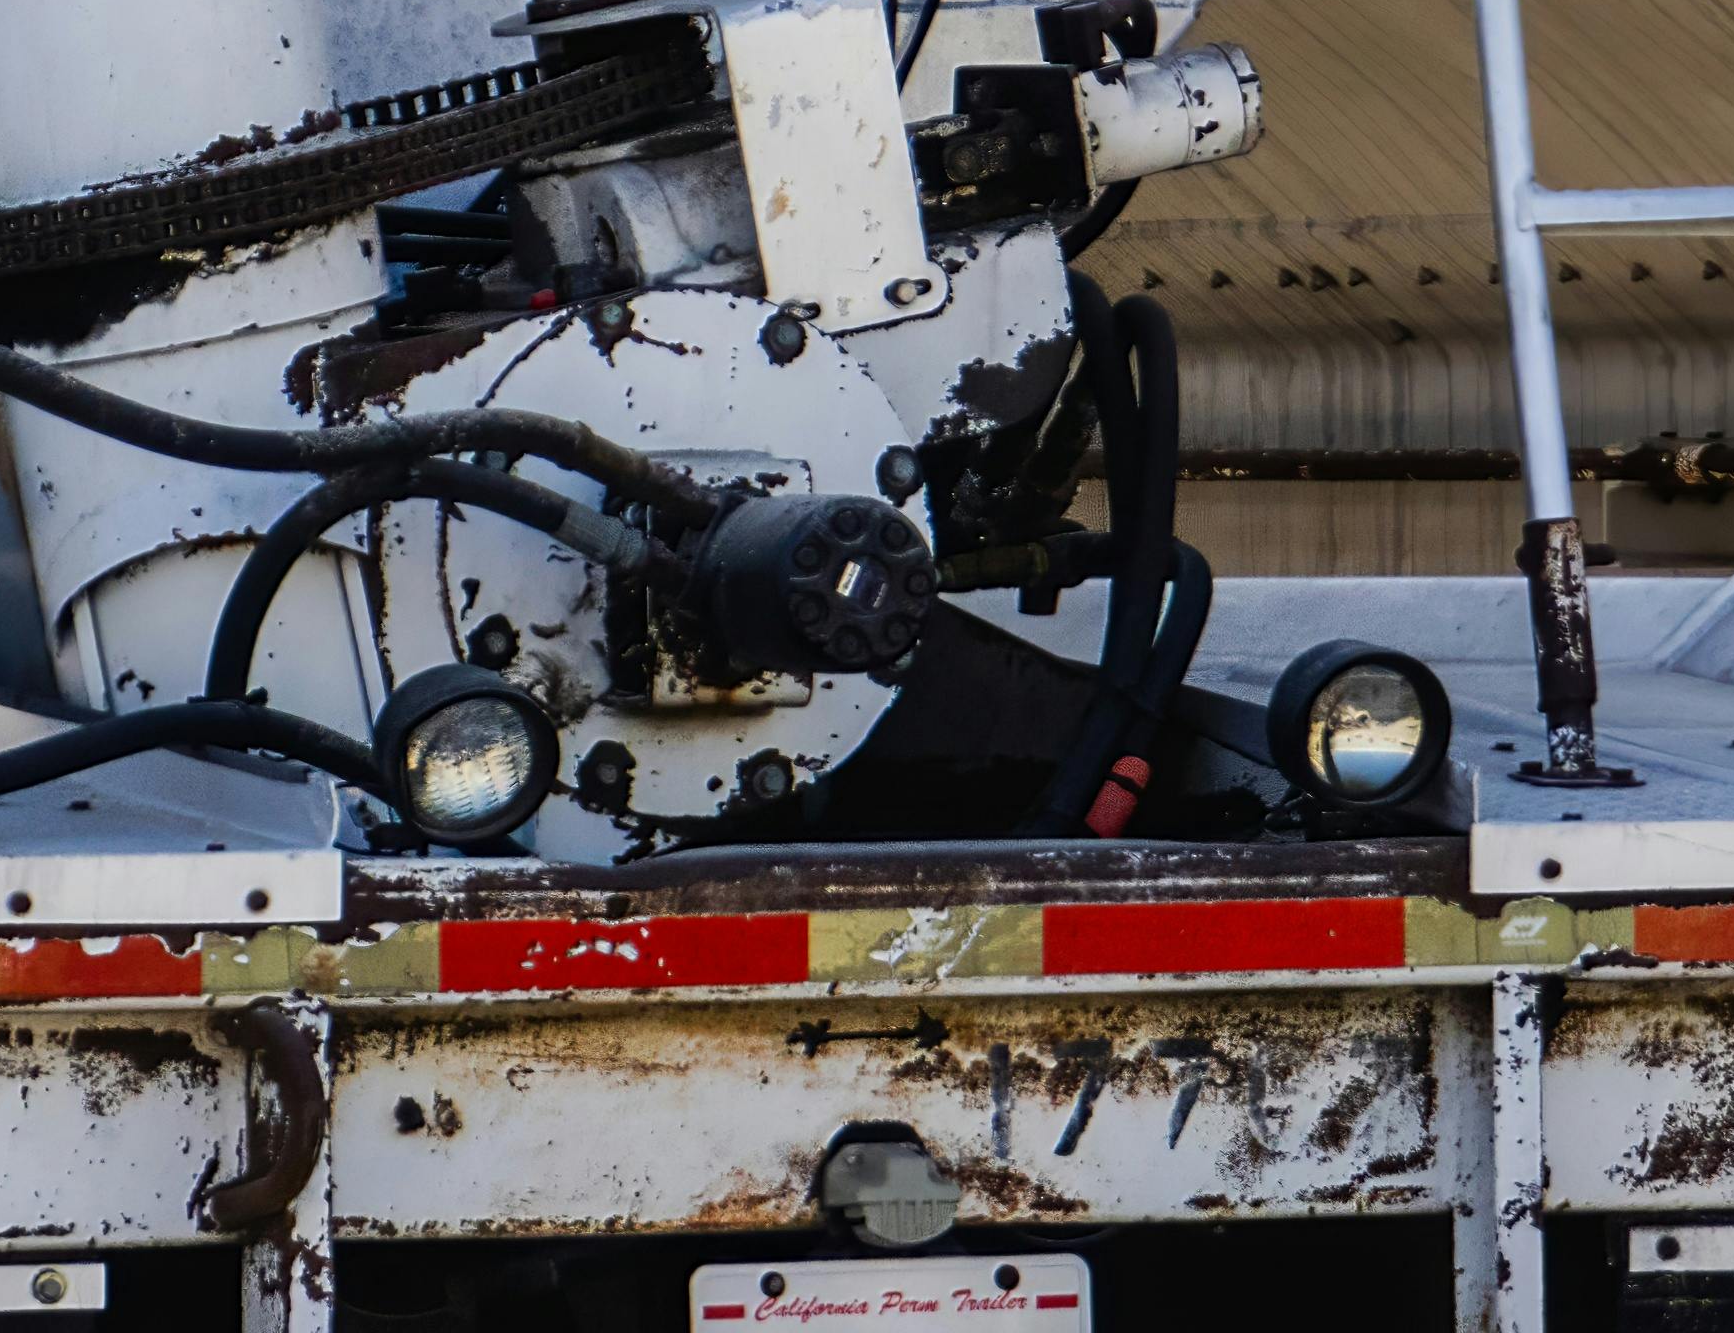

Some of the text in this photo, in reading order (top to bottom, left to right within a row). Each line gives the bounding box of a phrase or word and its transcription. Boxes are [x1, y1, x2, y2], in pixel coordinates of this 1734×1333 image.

[755, 1288, 1028, 1323] California Perm Trailer
